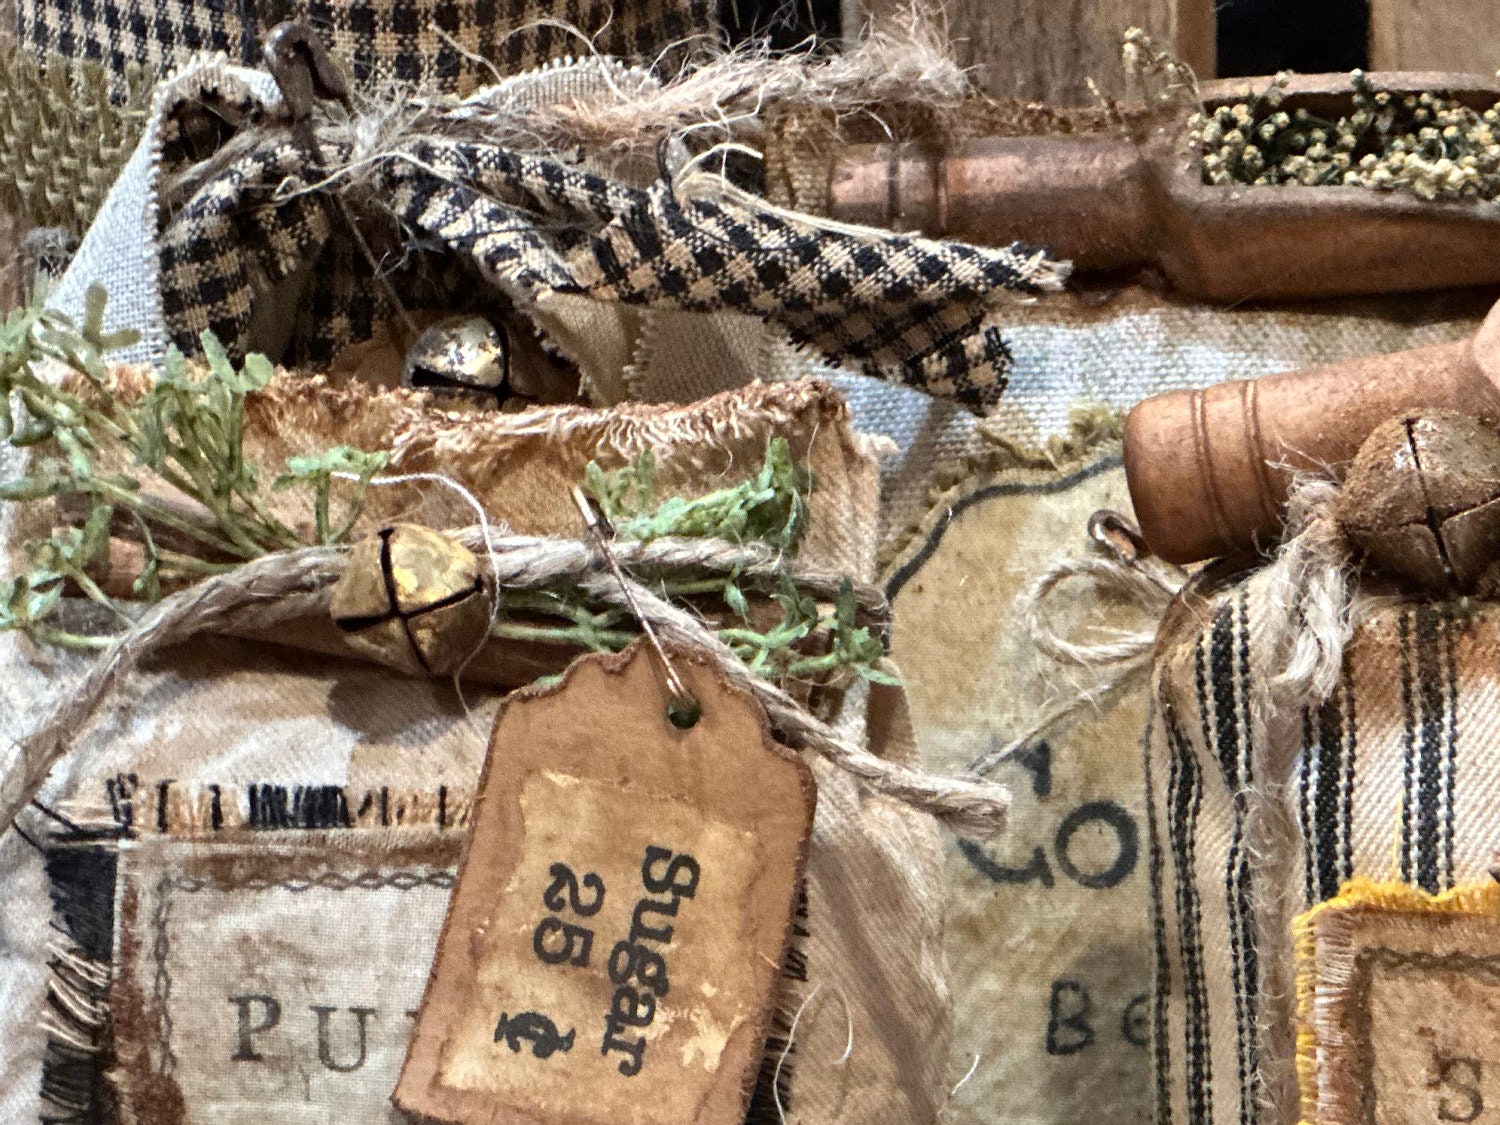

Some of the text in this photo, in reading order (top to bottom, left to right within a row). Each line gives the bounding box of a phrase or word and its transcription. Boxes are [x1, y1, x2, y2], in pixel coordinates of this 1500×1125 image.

[531, 862, 606, 968] 25
[600, 843, 700, 1079] Sugar
[228, 993, 422, 1074] PU
